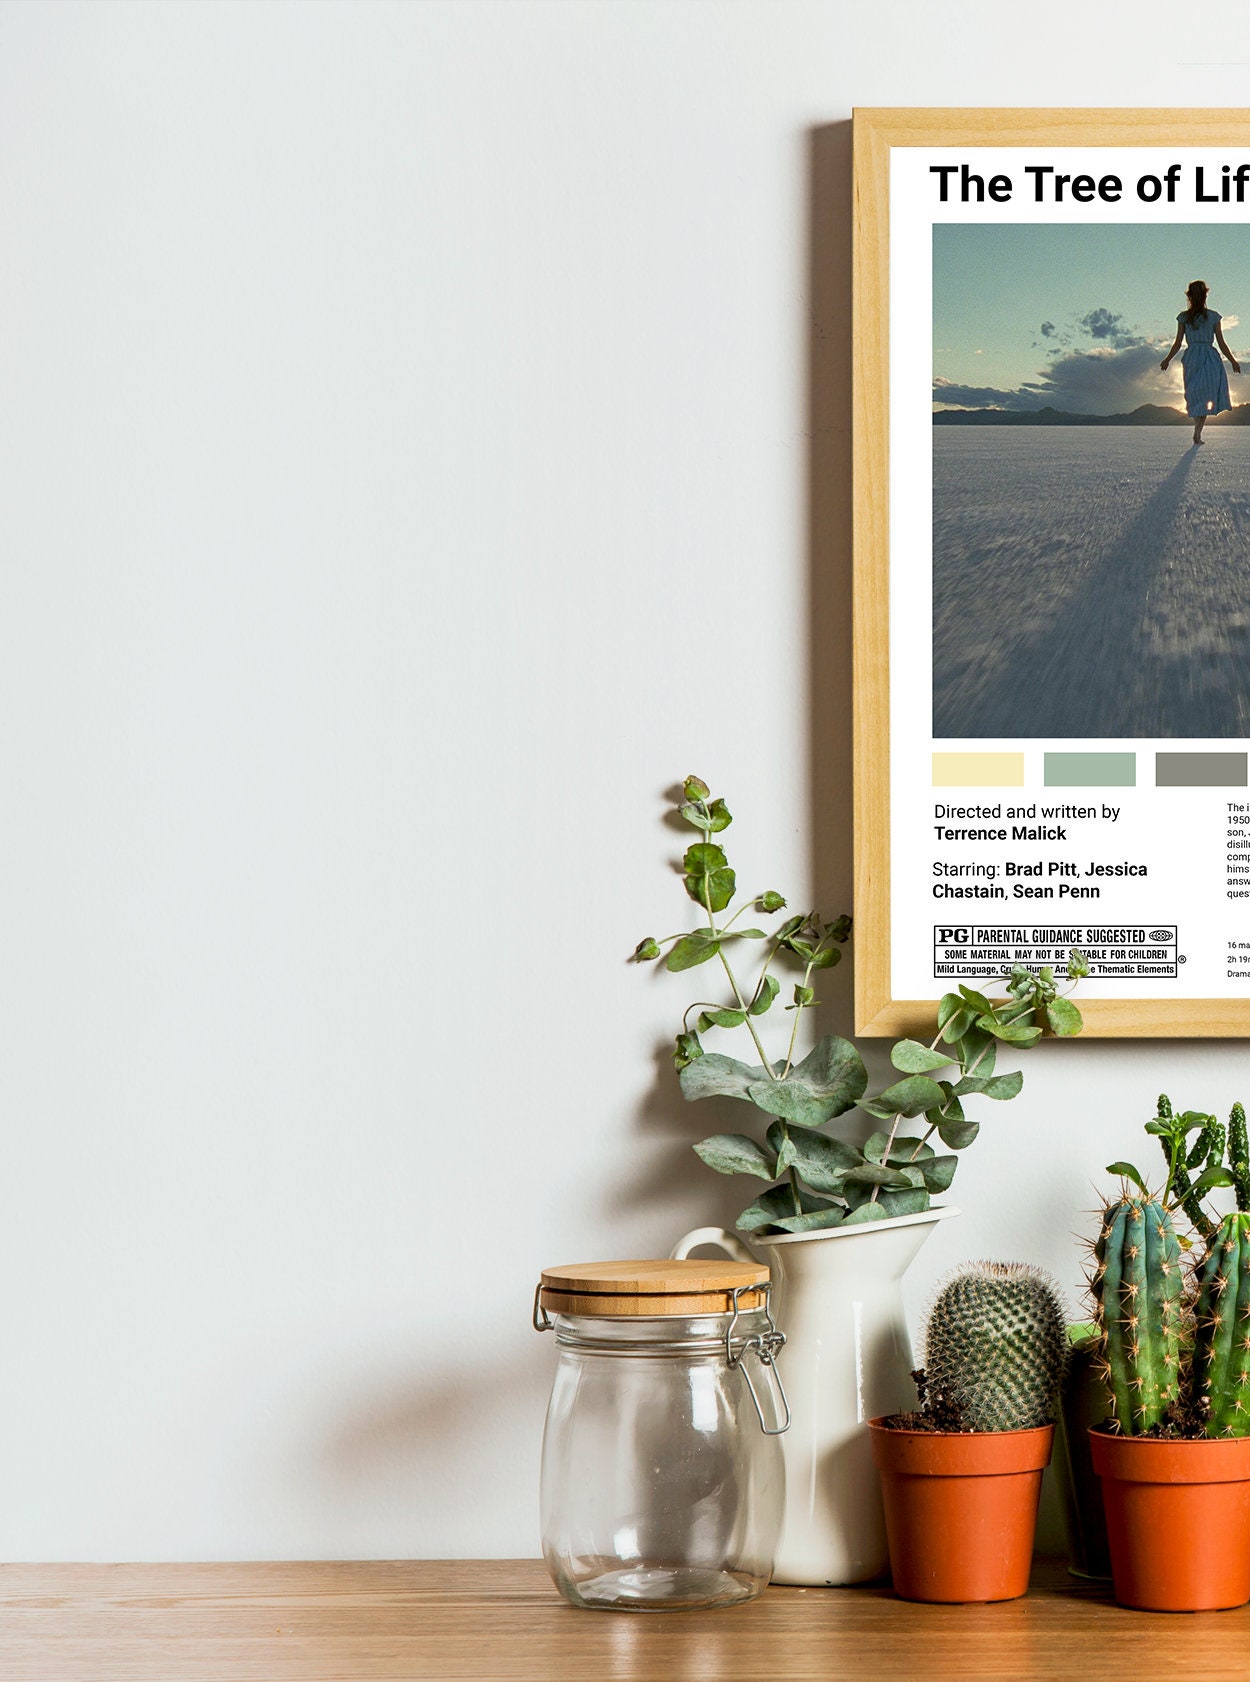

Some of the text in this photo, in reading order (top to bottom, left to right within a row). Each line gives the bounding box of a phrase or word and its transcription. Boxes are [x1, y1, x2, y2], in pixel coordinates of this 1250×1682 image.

[929, 164, 1012, 202] The
[1025, 166, 1122, 202] Tree
[1137, 164, 1181, 202] of
[935, 804, 1120, 822] Directed and written by
[1227, 803, 1244, 812] The
[934, 825, 1066, 840] Terrence Malick
[1227, 829, 1246, 838] son,
[933, 861, 1147, 880] Starring: Brad Pitt, Jessica
[933, 884, 1100, 900] Chastain, Sean Penn
[939, 929, 969, 943] PG
[978, 929, 1145, 943] PARENTAL GUIDANCE SUGGESTED
[945, 950, 1167, 960] SOME MATERIAL MAY NOT BE STABLE FOR CHILDREN
[937, 965, 954, 973] Mild
[957, 965, 998, 975] Language,
[1055, 964, 1068, 974] An
[1097, 965, 1135, 973] Thematic
[1137, 965, 1174, 973] Elements
